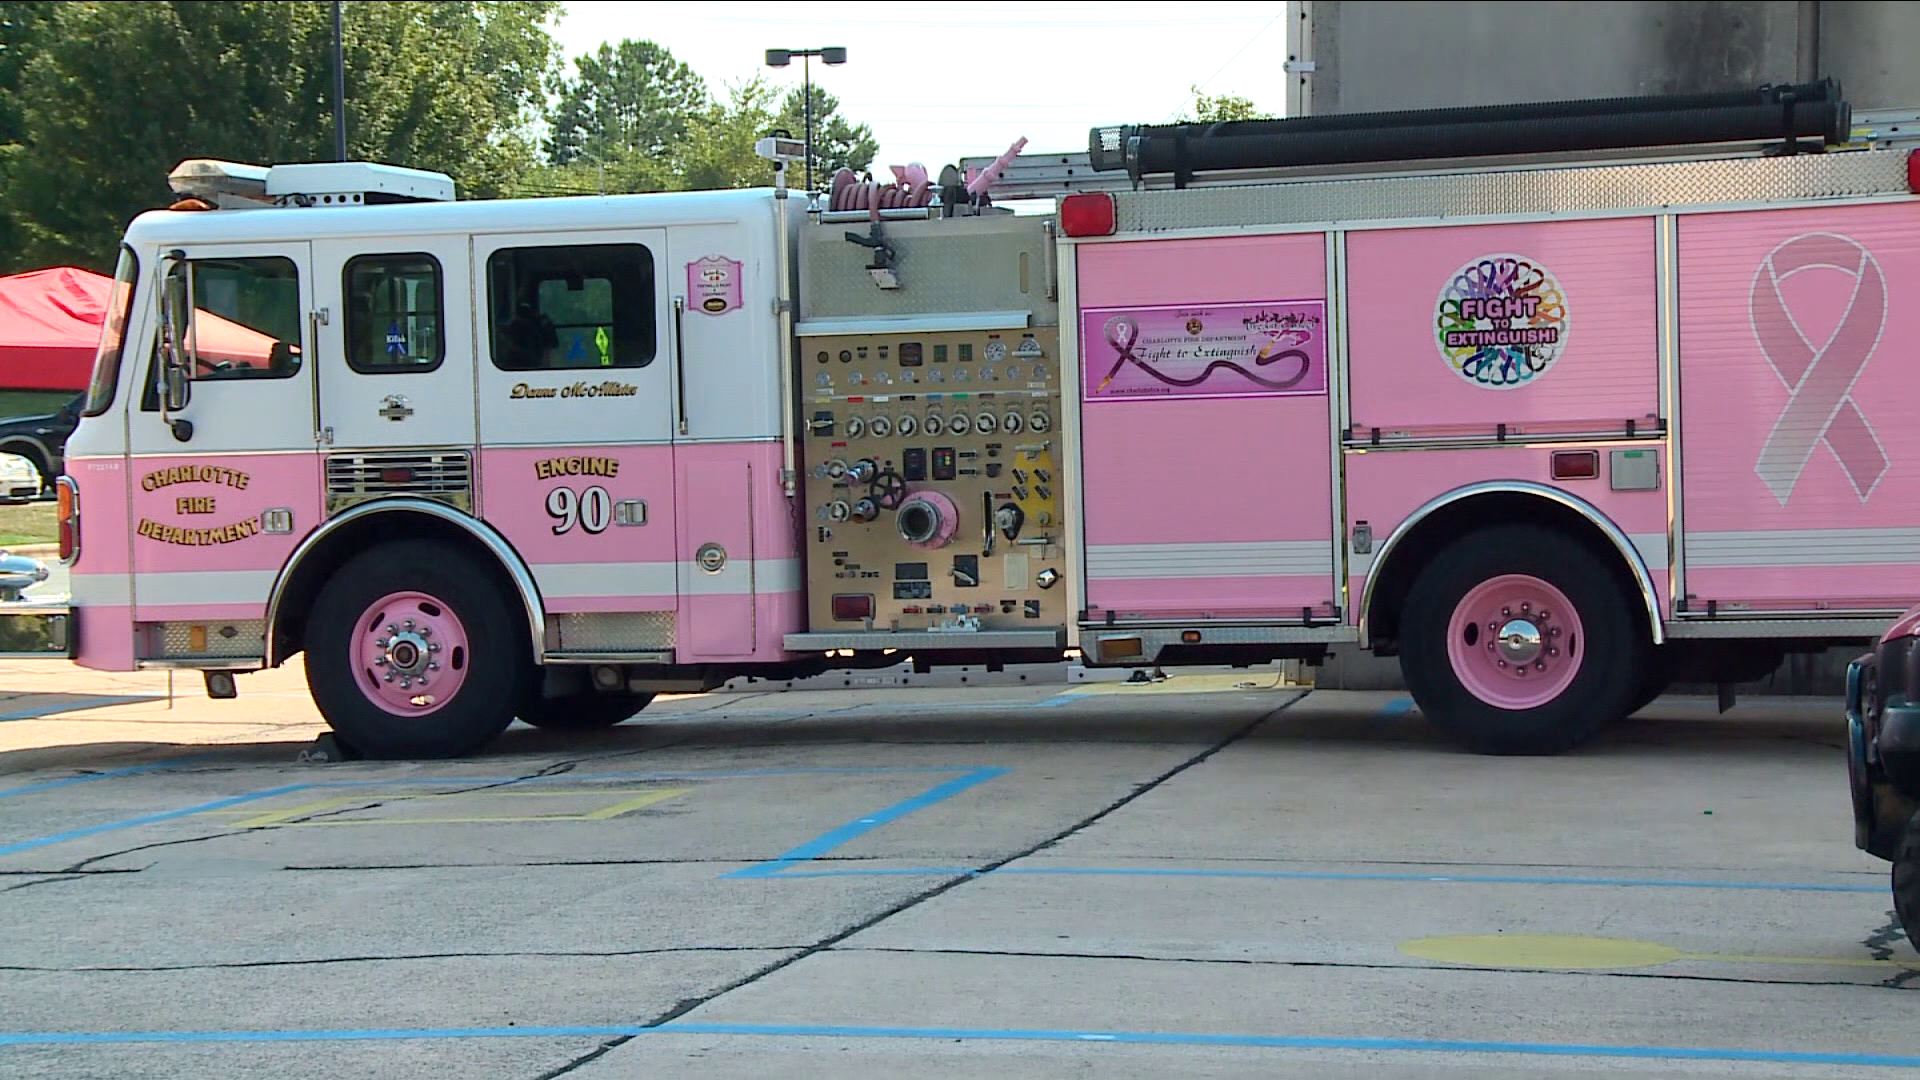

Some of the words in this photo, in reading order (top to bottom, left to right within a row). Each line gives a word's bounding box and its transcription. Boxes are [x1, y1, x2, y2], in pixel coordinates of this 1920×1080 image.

[1461, 296, 1541, 319] FIGHT
[1492, 318, 1511, 329] TO
[1446, 328, 1557, 347] EXTINGUISH!
[1135, 347, 1171, 362] Fight
[1177, 349, 1188, 358] to
[1194, 345, 1257, 360] Extinguish
[142, 465, 250, 491] CHARLOTTE
[535, 456, 619, 480] ENGINE
[176, 496, 216, 514] FIRE
[545, 485, 611, 535] 90
[137, 517, 259, 546] DEPARTMENT
